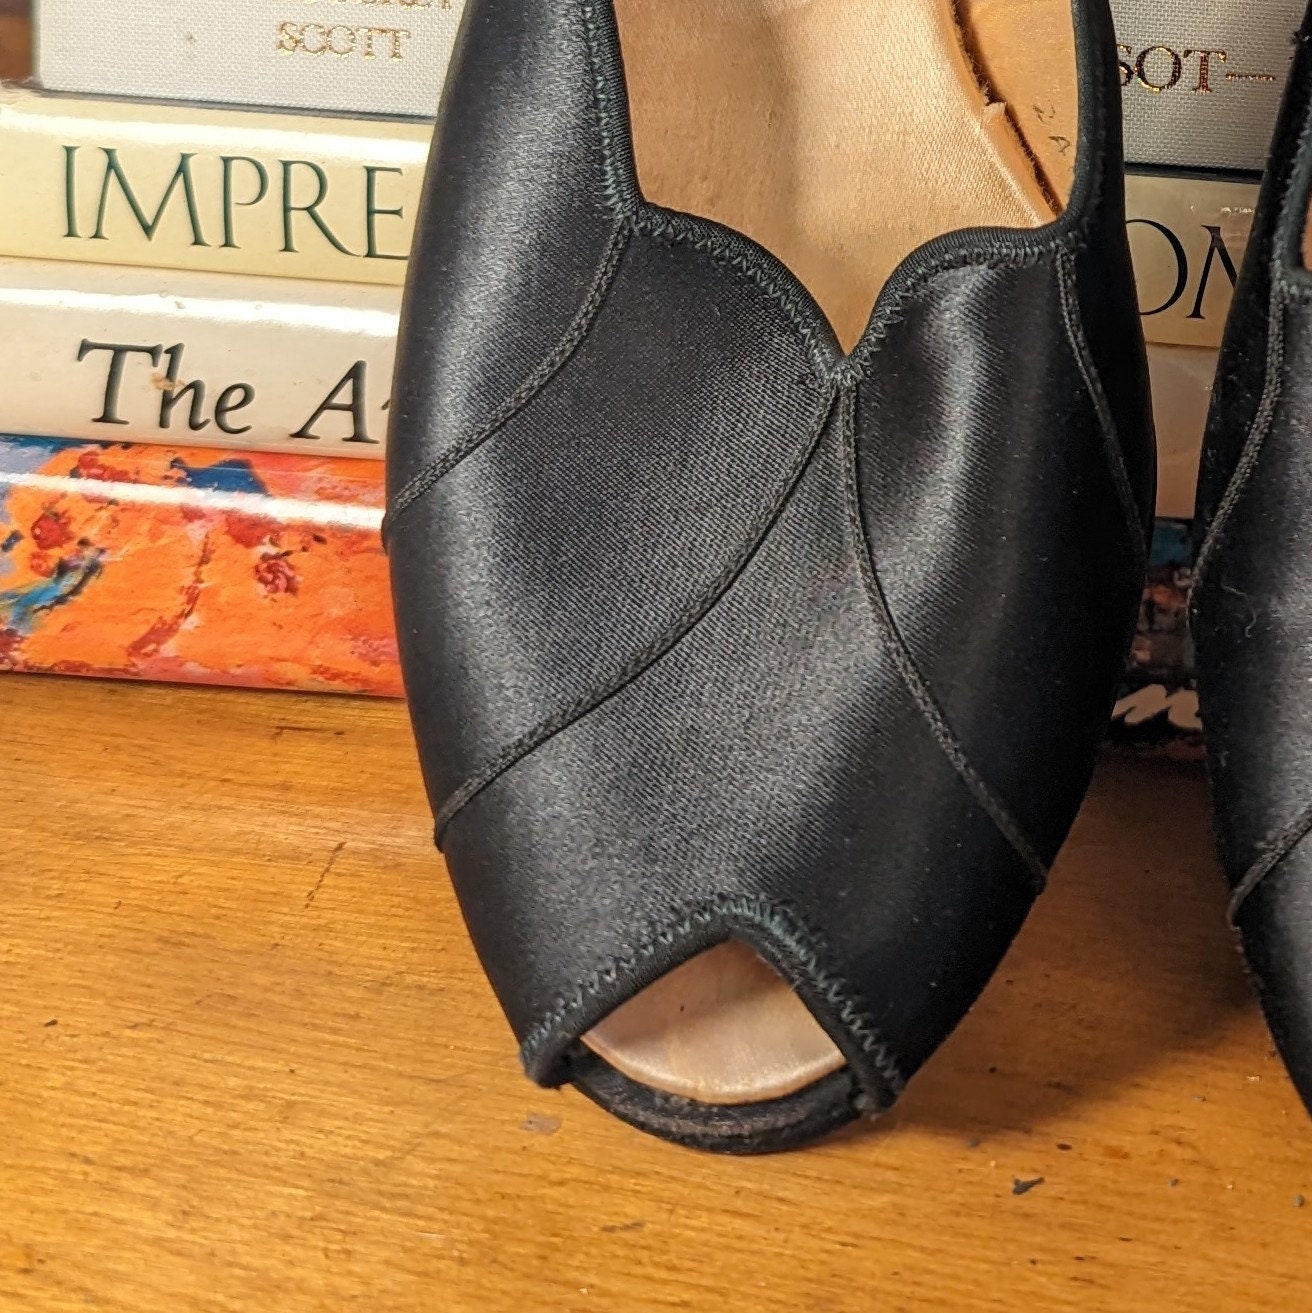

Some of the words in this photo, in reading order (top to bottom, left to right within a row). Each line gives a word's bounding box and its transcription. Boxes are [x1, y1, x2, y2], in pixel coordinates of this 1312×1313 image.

[277, 21, 412, 62] SCOTT
[60, 145, 411, 261] IMPRE
[77, 337, 256, 434] The
[289, 359, 391, 445] A
